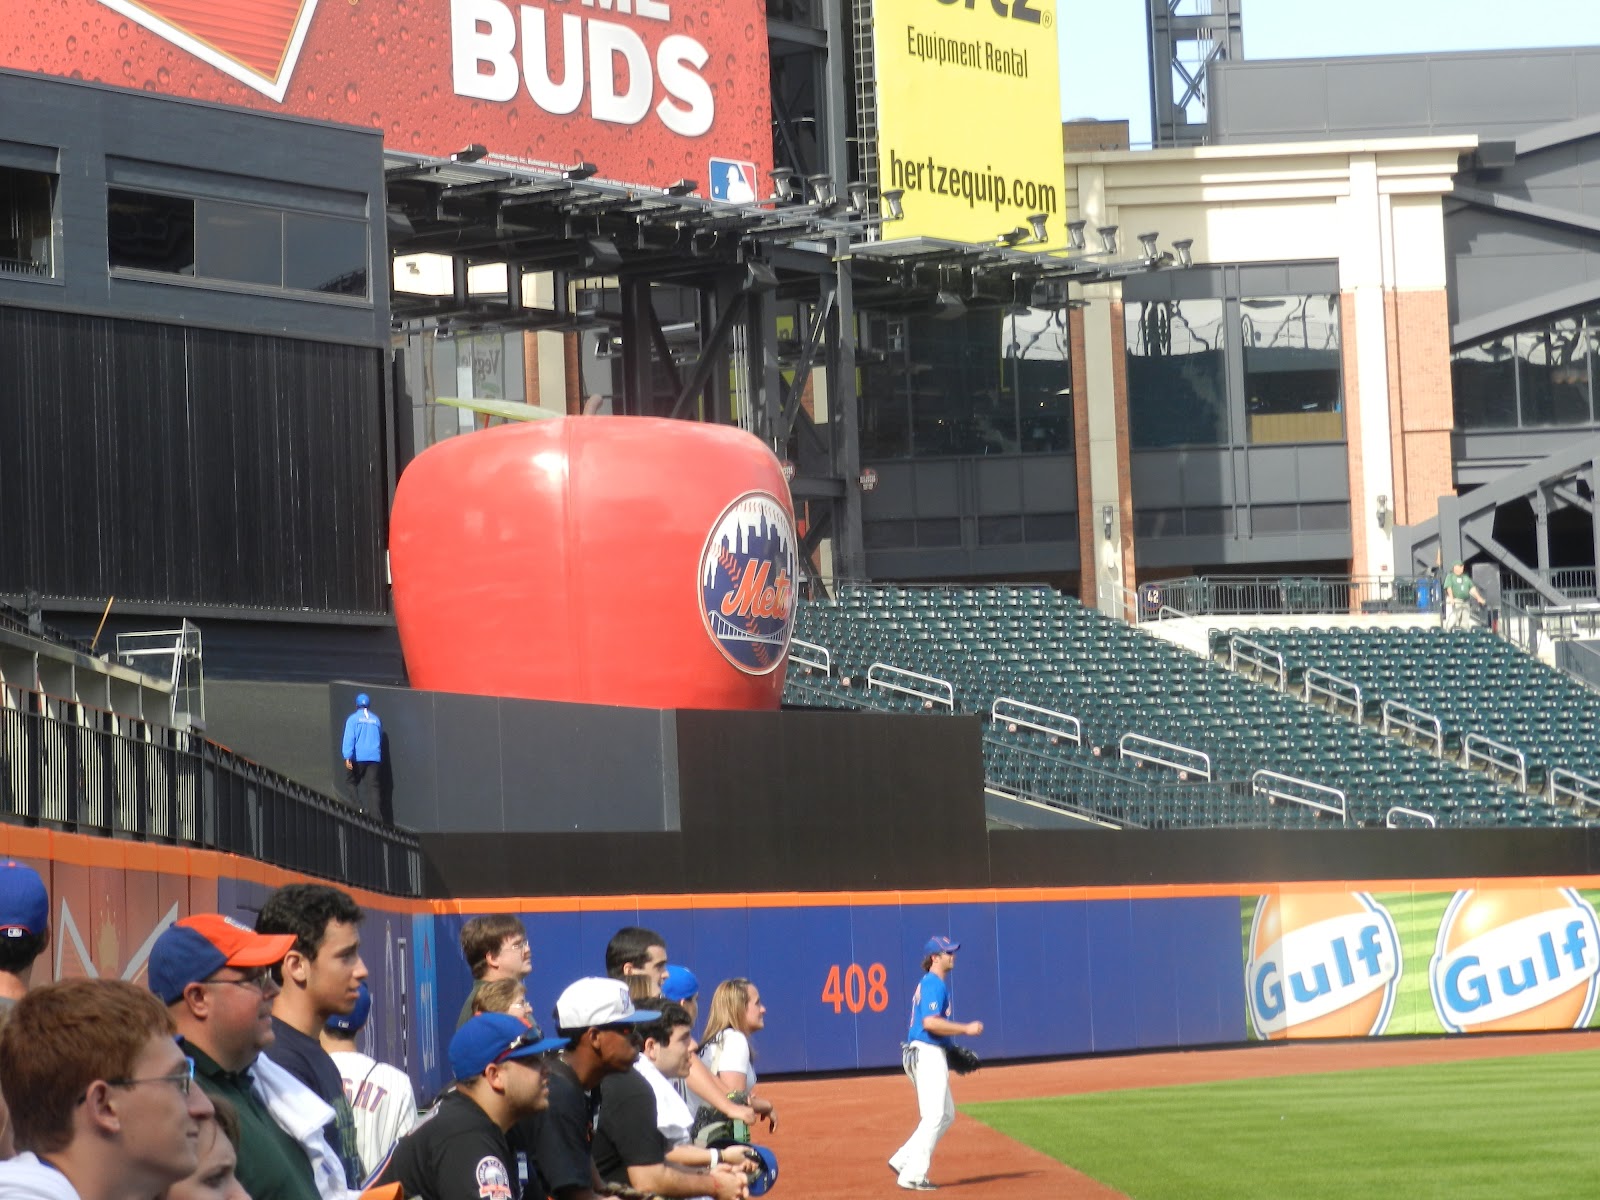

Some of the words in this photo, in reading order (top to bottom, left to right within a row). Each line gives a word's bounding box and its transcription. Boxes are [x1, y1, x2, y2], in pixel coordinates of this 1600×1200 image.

[450, 0, 715, 137] BUDS
[907, 25, 982, 69] Equipment
[985, 42, 1028, 79] Rental
[890, 149, 1057, 214] hertzequip.com
[721, 558, 790, 619] Mets
[821, 962, 889, 1014] 408
[1255, 925, 1382, 1021] Gulf
[1444, 920, 1586, 1014] Gulf
